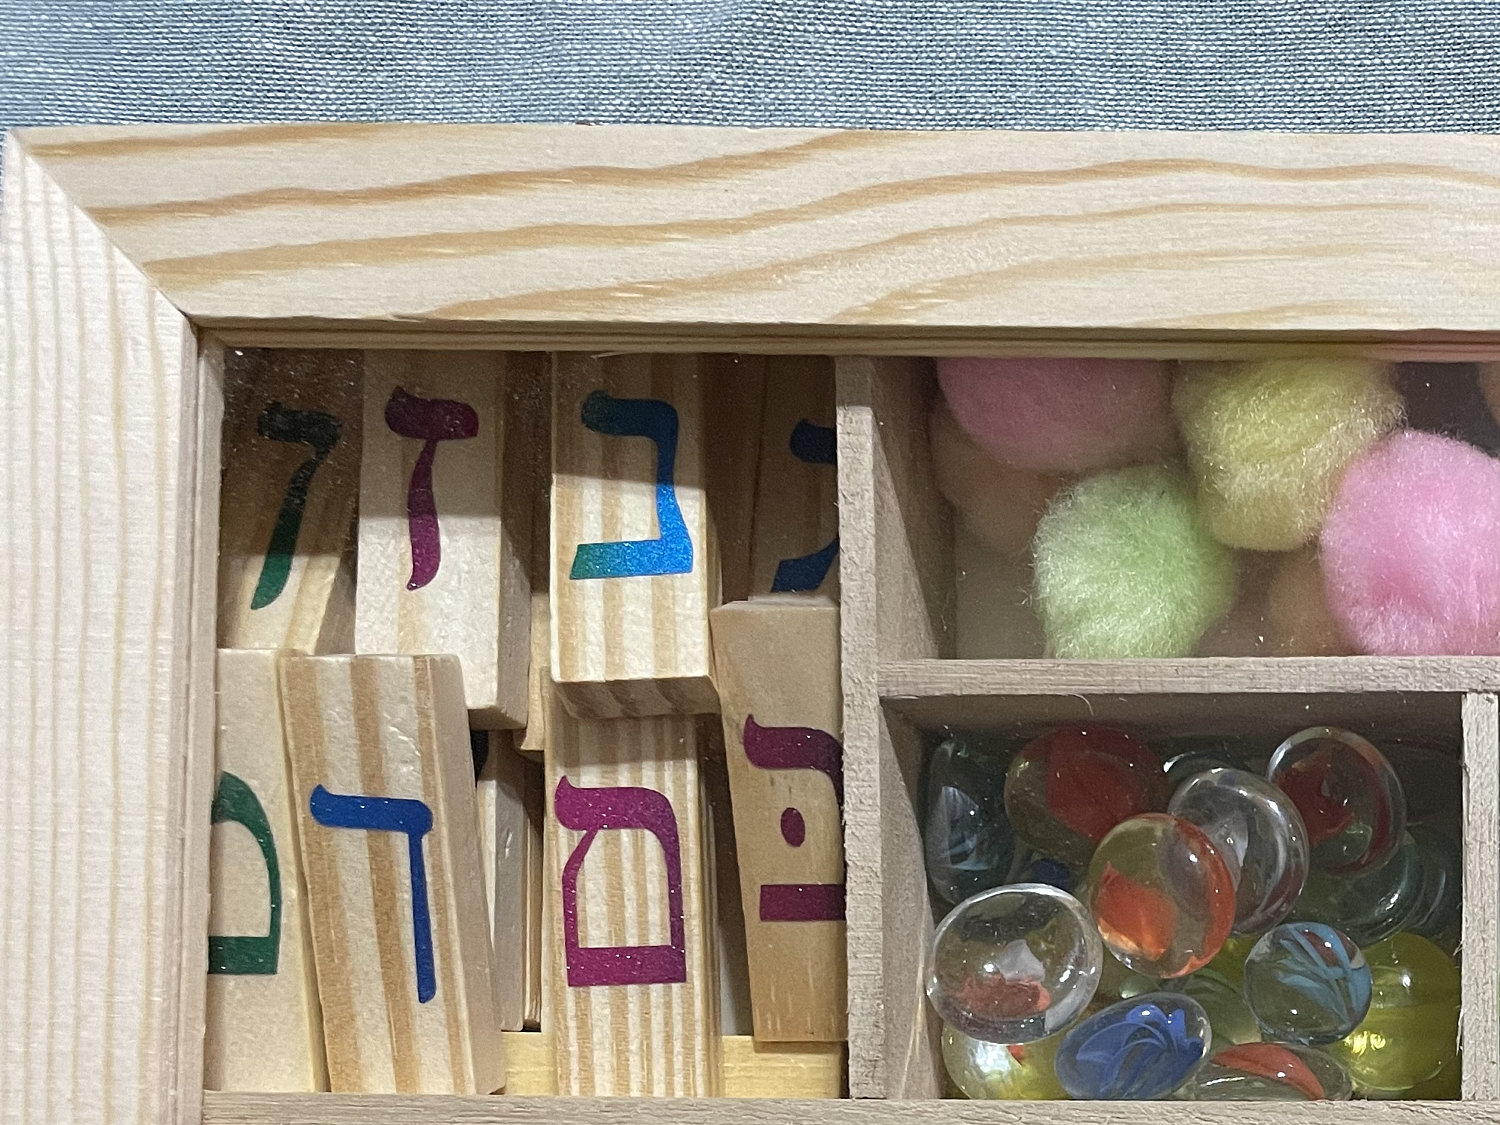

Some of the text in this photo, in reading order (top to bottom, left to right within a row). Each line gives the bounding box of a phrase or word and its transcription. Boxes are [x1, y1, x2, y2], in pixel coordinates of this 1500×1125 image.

[581, 390, 694, 579] נ
[310, 784, 436, 1004] ד
[555, 775, 687, 987] ם
